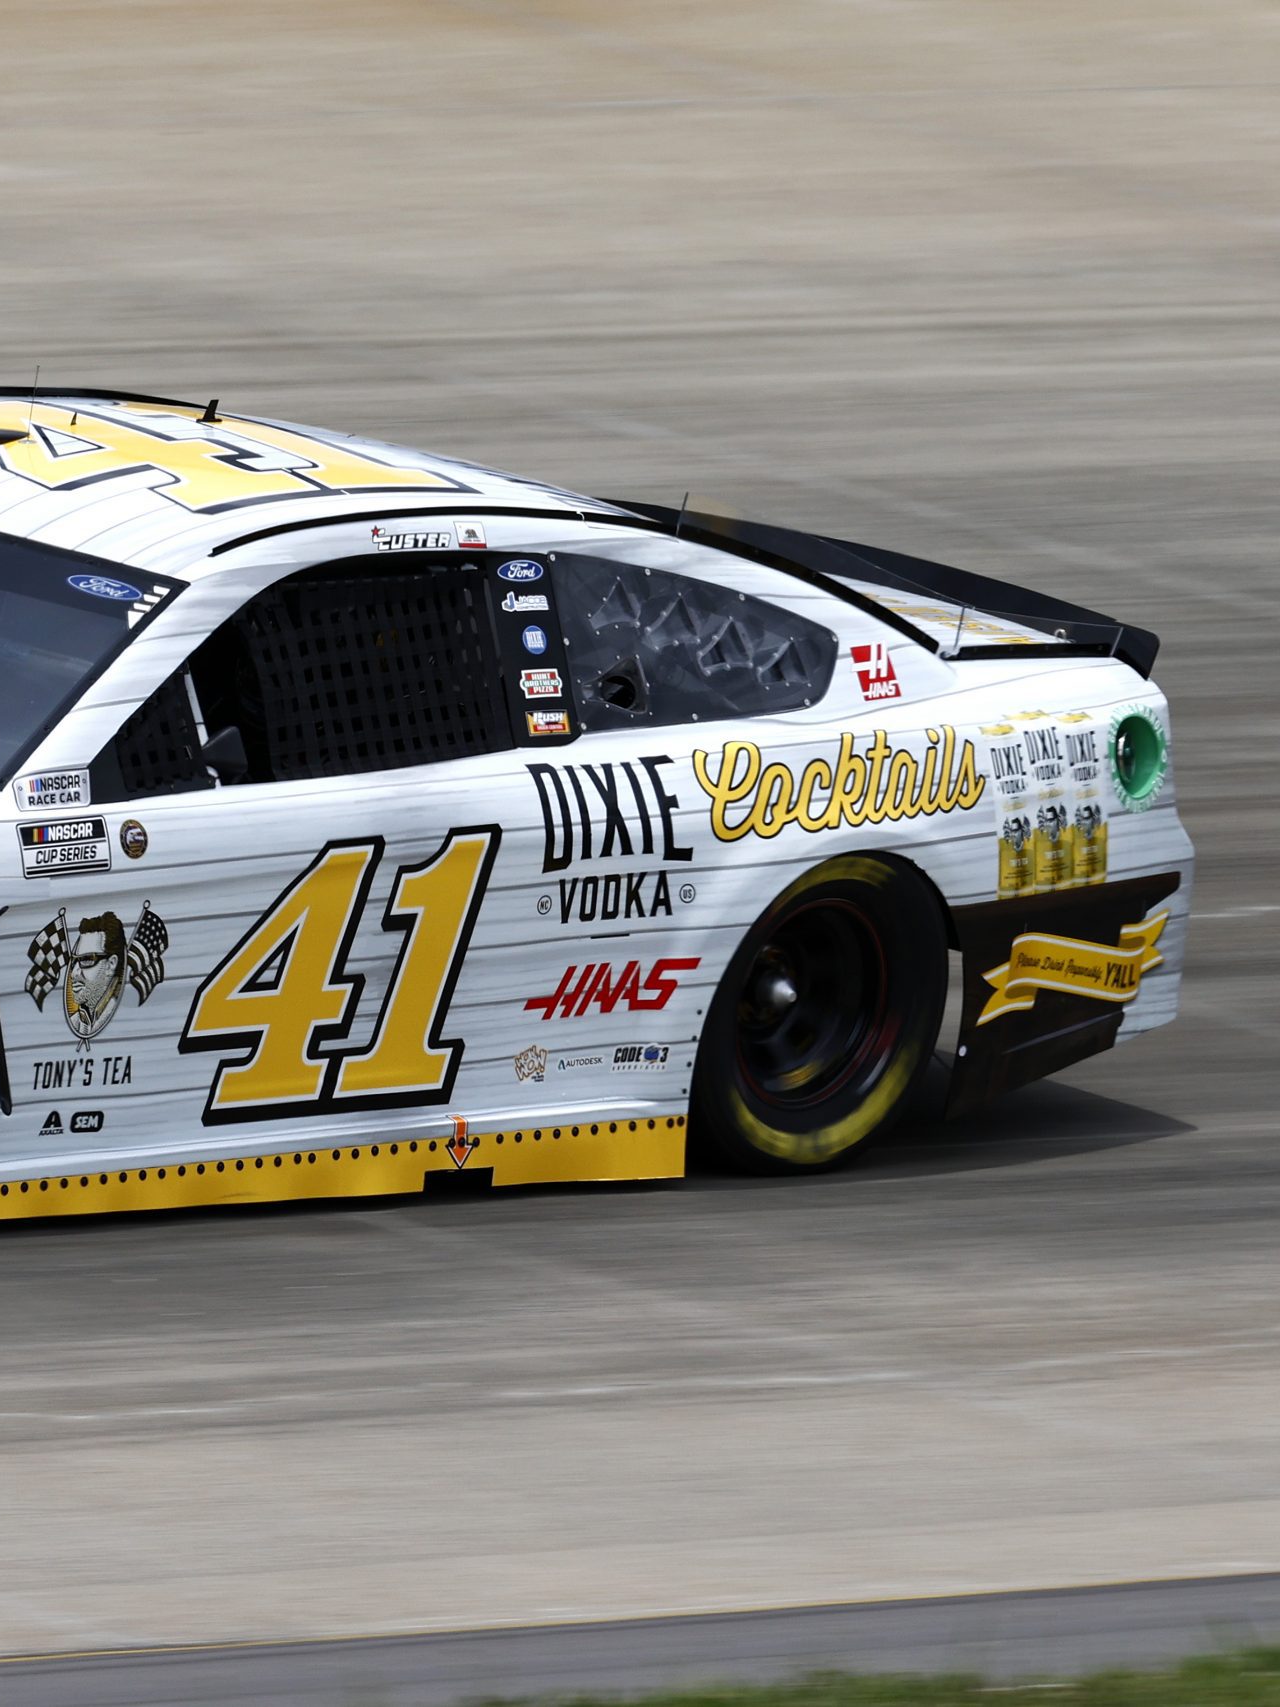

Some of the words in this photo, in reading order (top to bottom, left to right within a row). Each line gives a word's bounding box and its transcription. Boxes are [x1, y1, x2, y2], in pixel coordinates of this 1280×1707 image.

[371, 526, 451, 551] CUSTER
[508, 563, 535, 578] Ford
[79, 578, 130, 597] Ford
[861, 681, 899, 698] HAAS
[533, 712, 563, 725] RUSH
[1024, 726, 1063, 764] DIXIE
[1065, 730, 1099, 767] DIXIE
[990, 743, 1027, 779] DIXIE
[40, 775, 80, 792] NASCAR
[692, 725, 985, 843] Cocktails
[28, 793, 56, 806] RACE
[60, 791, 81, 803] CAR
[525, 755, 694, 873] DIXIE
[48, 823, 93, 841] NASCAR
[36, 849, 58, 864] CUP
[60, 845, 97, 861] SERIES
[559, 870, 673, 924] VODKA
[178, 823, 502, 1127] 41
[1104, 962, 1136, 988] Y'ALL
[523, 957, 702, 1020] HAAS
[566, 1056, 603, 1067] AUTODESK
[613, 1046, 643, 1063] CODE
[660, 1046, 669, 1063] 3
[33, 1058, 94, 1090] TONY'S
[103, 1056, 131, 1085] TEA
[74, 1115, 99, 1129] SEM
